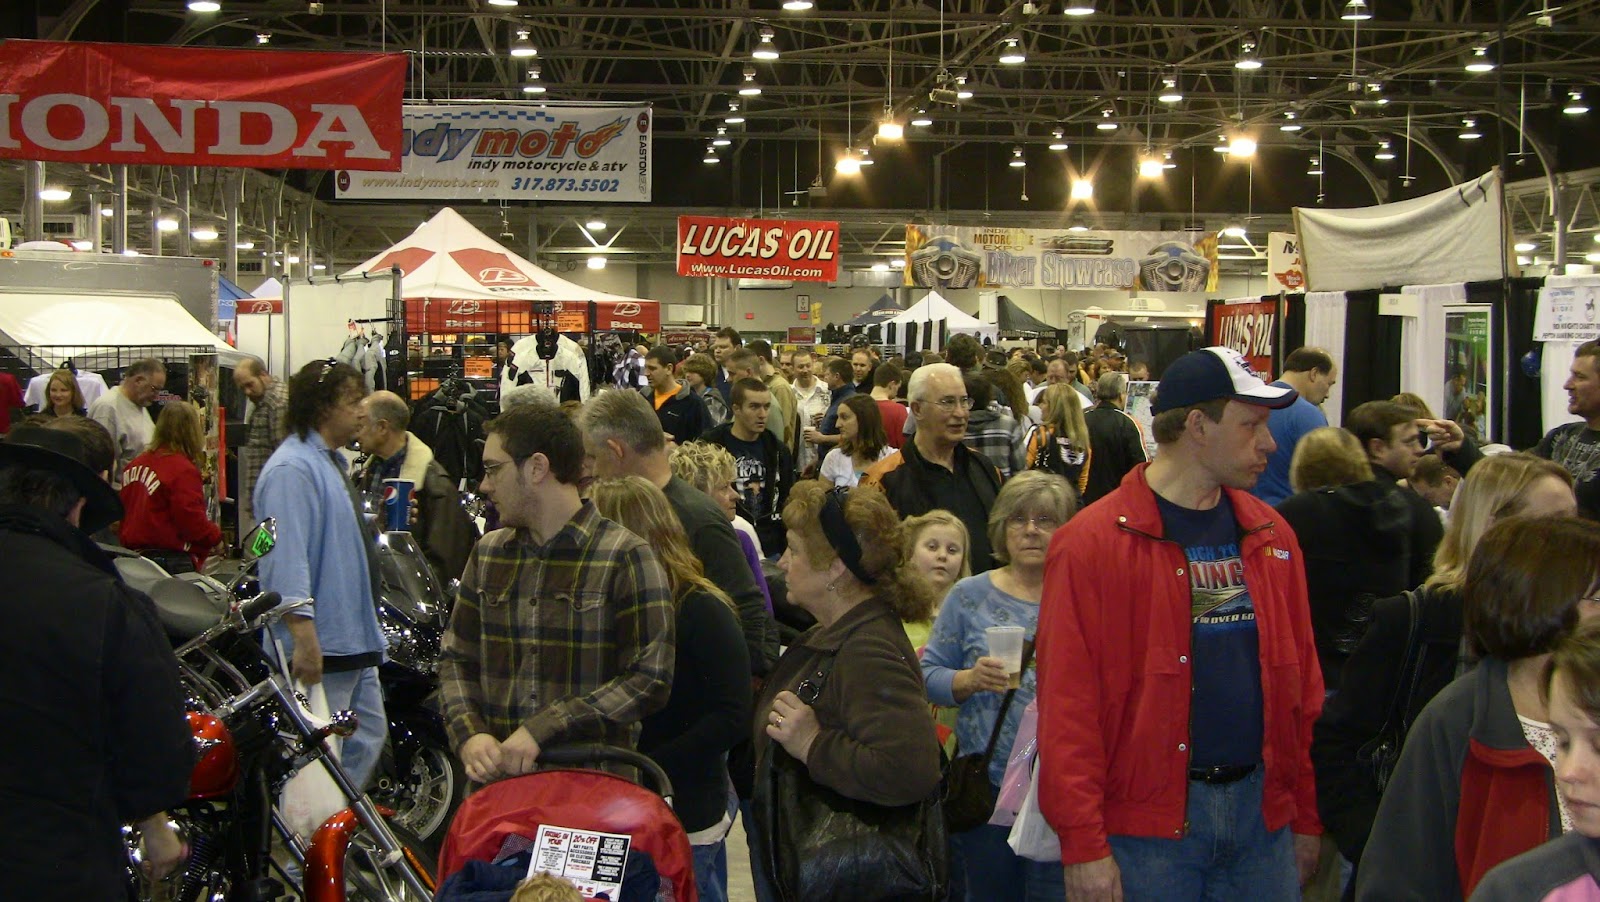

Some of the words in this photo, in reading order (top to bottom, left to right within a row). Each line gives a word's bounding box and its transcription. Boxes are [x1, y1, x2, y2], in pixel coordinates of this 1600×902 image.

[0, 94, 391, 160] ONDA
[401, 121, 608, 164] dymoto
[639, 135, 647, 176] EASTON
[467, 159, 500, 172] indy
[502, 160, 587, 173] motorcycle
[589, 161, 599, 172] &
[601, 162, 628, 172] atv
[362, 176, 499, 190] www.indymoto.com
[511, 177, 620, 193] 317.873.5502
[682, 224, 783, 259] LUCAS
[788, 229, 834, 260] OIL
[974, 233, 1034, 246] MOTORCE
[691, 263, 823, 277] www.LucasOil.com
[985, 251, 1037, 287] Biker
[1041, 251, 1135, 289] Showcase
[610, 320, 644, 329] Beta
[1219, 314, 1253, 357] LUCAS
[1253, 314, 1274, 356] OIL
[123, 465, 160, 495] NDIANA
[1186, 546, 1216, 560] UGH
[1190, 560, 1246, 592] LING
[1210, 613, 1240, 624] OVER
[586, 836, 598, 844] OFF
